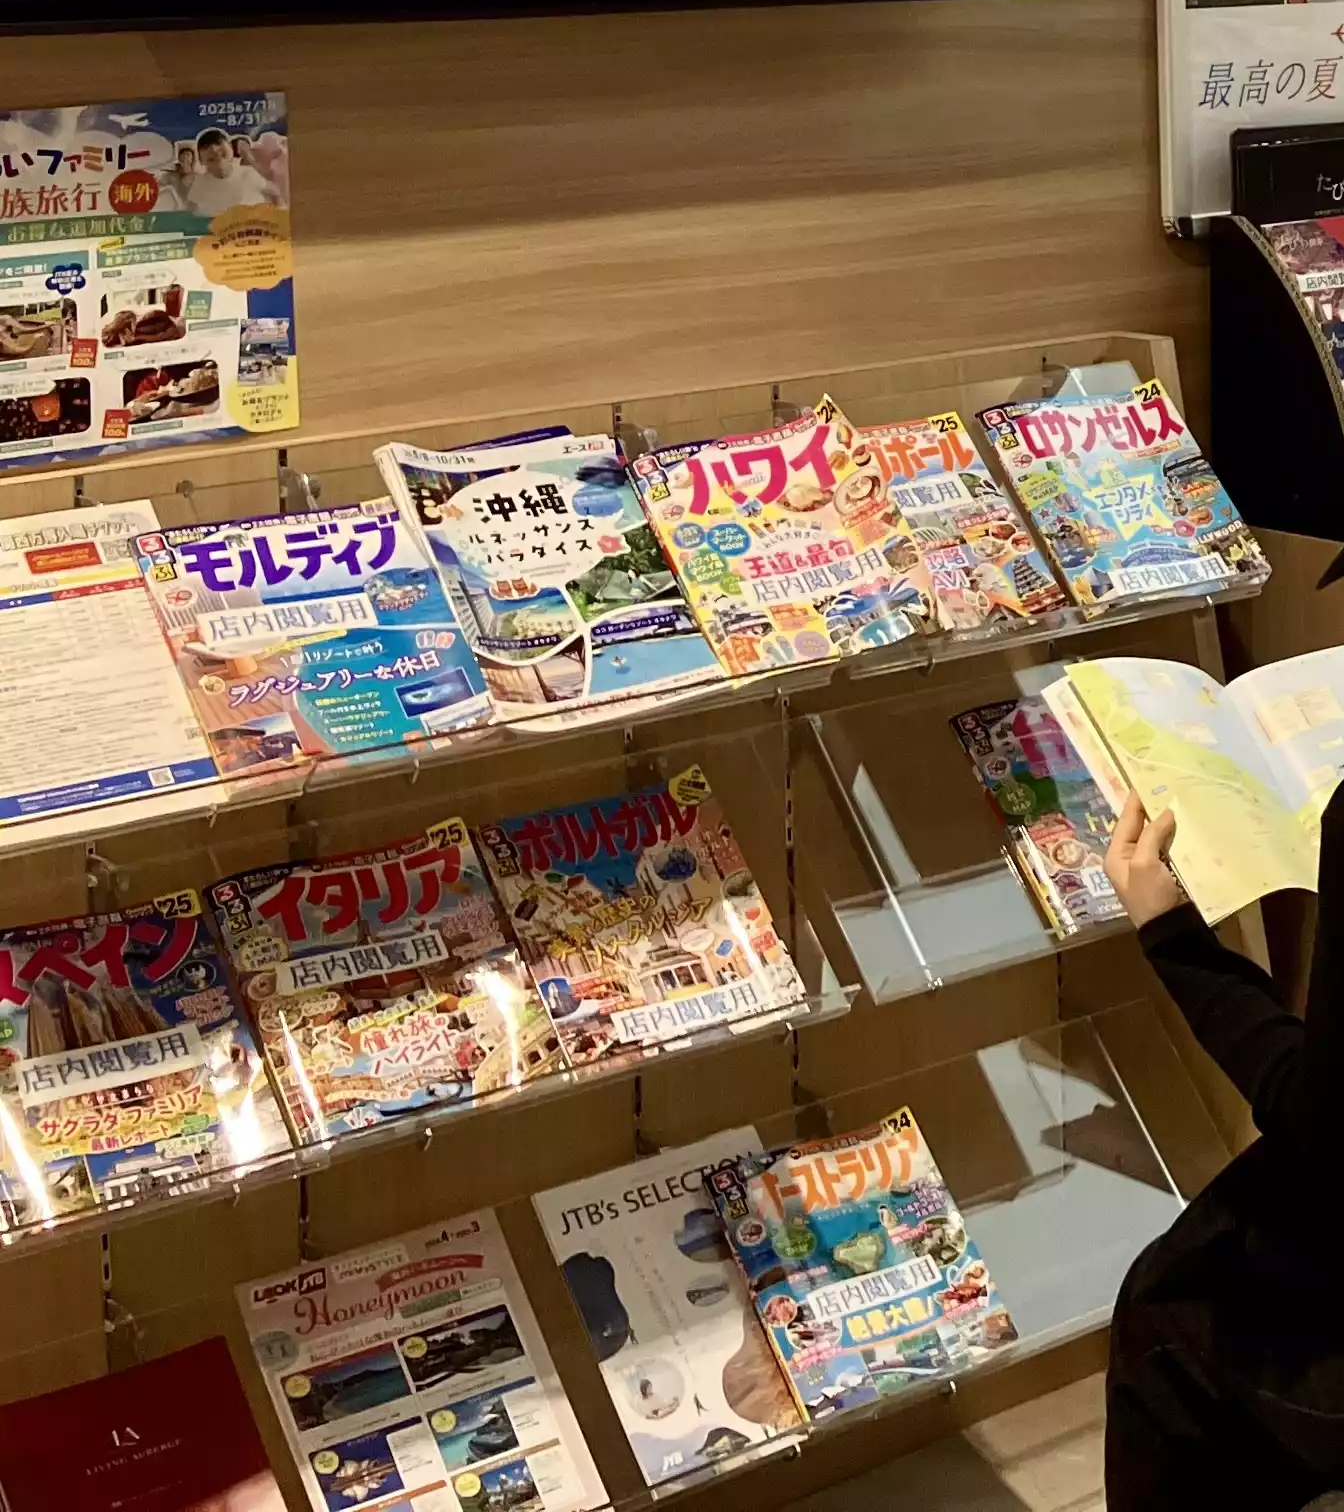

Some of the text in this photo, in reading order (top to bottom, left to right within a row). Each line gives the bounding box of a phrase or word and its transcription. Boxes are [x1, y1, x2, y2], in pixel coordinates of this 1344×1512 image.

[1, 181, 153, 218] 族旅行 海外
[930, 415, 960, 433] '25
[1014, 396, 1185, 460] ロサンゼルス
[684, 424, 838, 517] ハワイ
[471, 482, 569, 524] 沖縄
[178, 509, 402, 593] モルディブ
[468, 518, 595, 545] ルネッサンス
[486, 539, 593, 564] パラダイス
[751, 547, 884, 603] 店内閲覧用
[1119, 555, 1228, 592] 店内閲覧用
[208, 598, 369, 643] 店内閲覧用
[513, 789, 700, 873] ポルトガル
[255, 845, 462, 941] イタリア
[289, 934, 443, 988] 店内閲覧用
[619, 982, 759, 1039] 店内閲覧用
[22, 1031, 191, 1096] 店内閲覧用
[560, 1198, 620, 1237] JTB's
[293, 1270, 466, 1336] Honeymoon
[813, 1258, 939, 1317] 店内閲覧用
